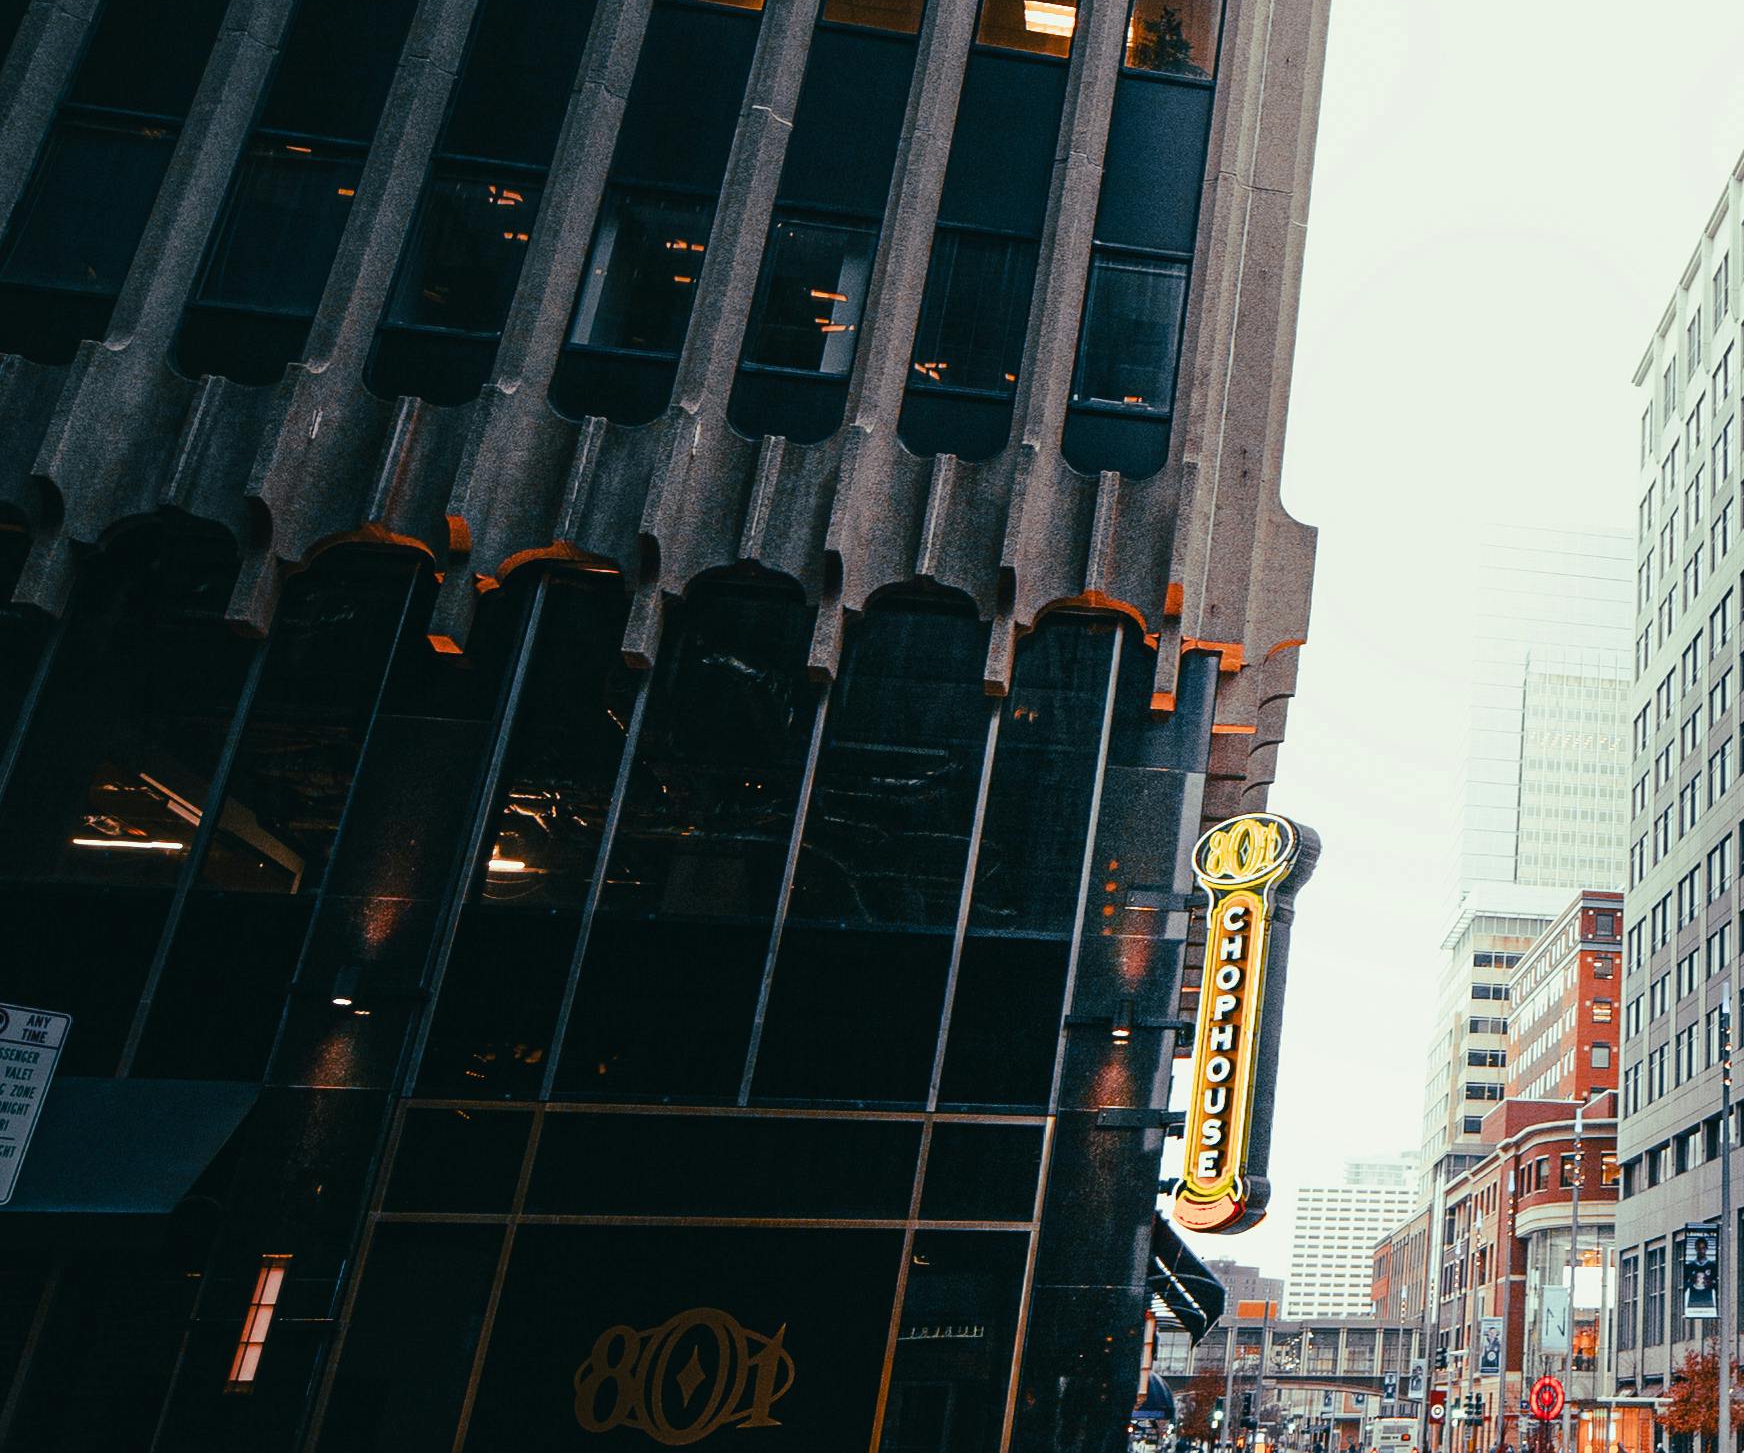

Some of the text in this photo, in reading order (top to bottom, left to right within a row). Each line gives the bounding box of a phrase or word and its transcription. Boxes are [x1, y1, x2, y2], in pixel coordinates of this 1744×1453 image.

[27, 1015, 51, 1028] ANY
[21, 1028, 48, 1043] TIME
[1198, 906, 1246, 1178] CHOPHOUSE
[5, 1066, 34, 1081] VALET
[10, 1084, 37, 1100] ZONE
[574, 1307, 796, 1445] 801
